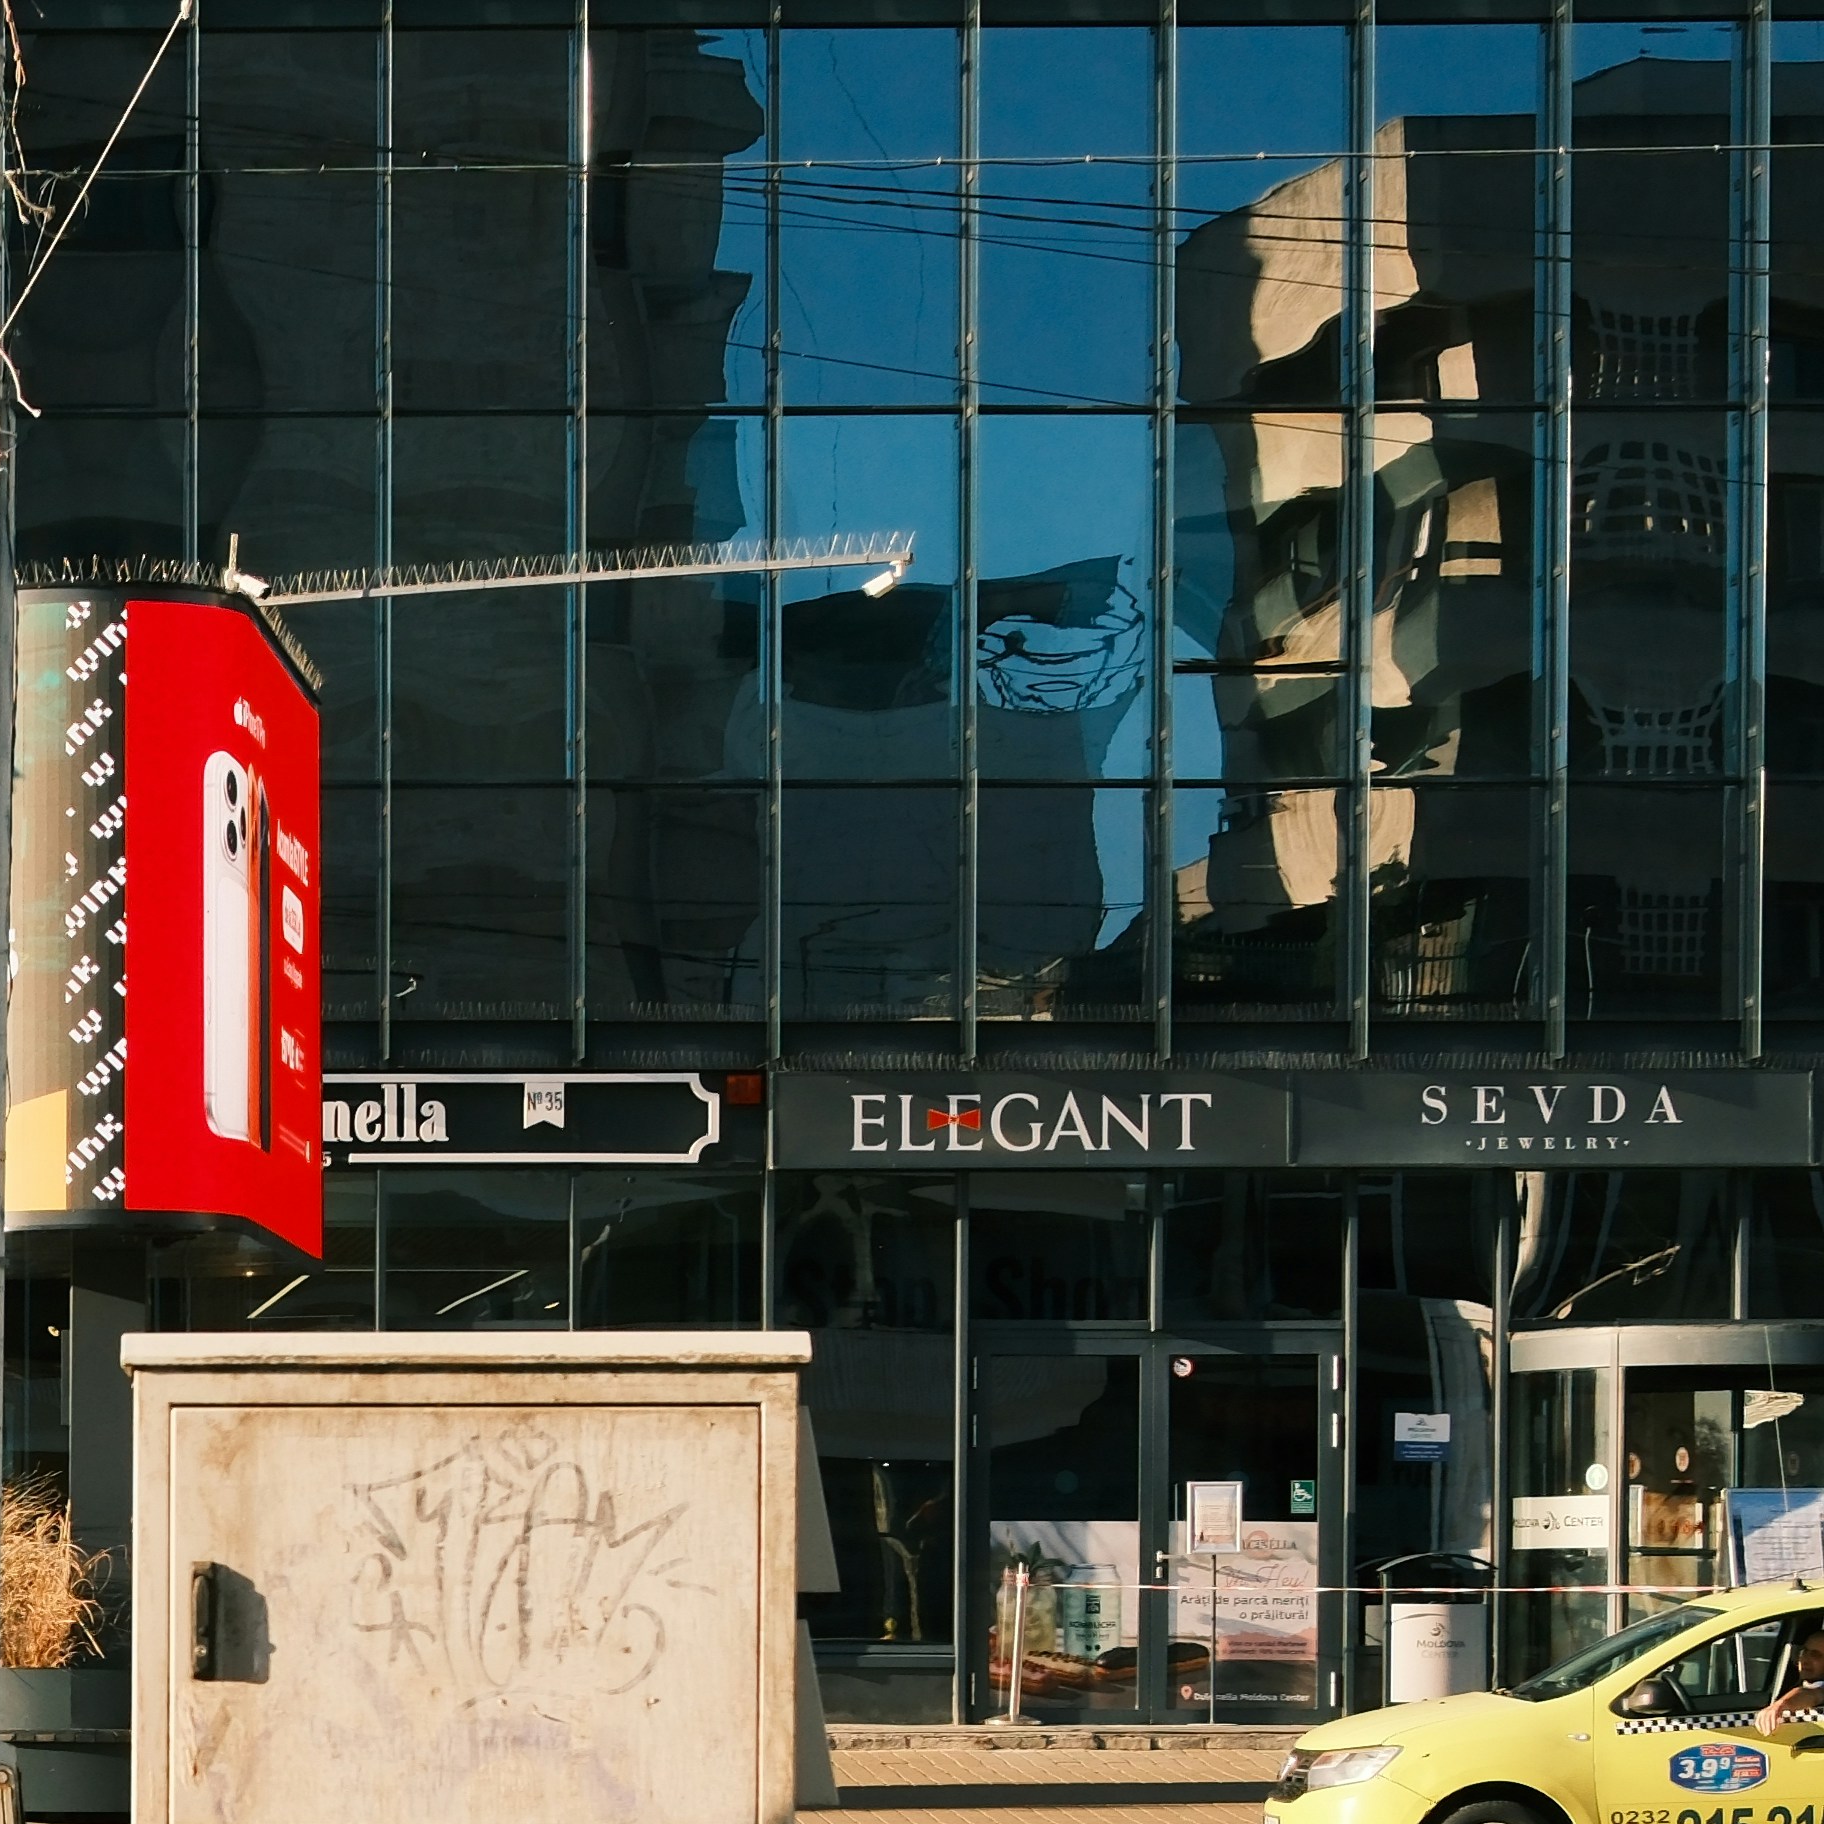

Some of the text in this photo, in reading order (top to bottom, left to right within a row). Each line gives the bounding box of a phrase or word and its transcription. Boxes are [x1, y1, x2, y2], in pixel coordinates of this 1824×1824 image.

[323, 1084, 449, 1143] nella
[1421, 1085, 1683, 1125] SEVDA
[851, 1093, 1212, 1152] ELEGANT
[1477, 1136, 1618, 1151] JEWELRY
[1564, 1515, 1604, 1527] CENTER
[1611, 1809, 1670, 1824] 0232
